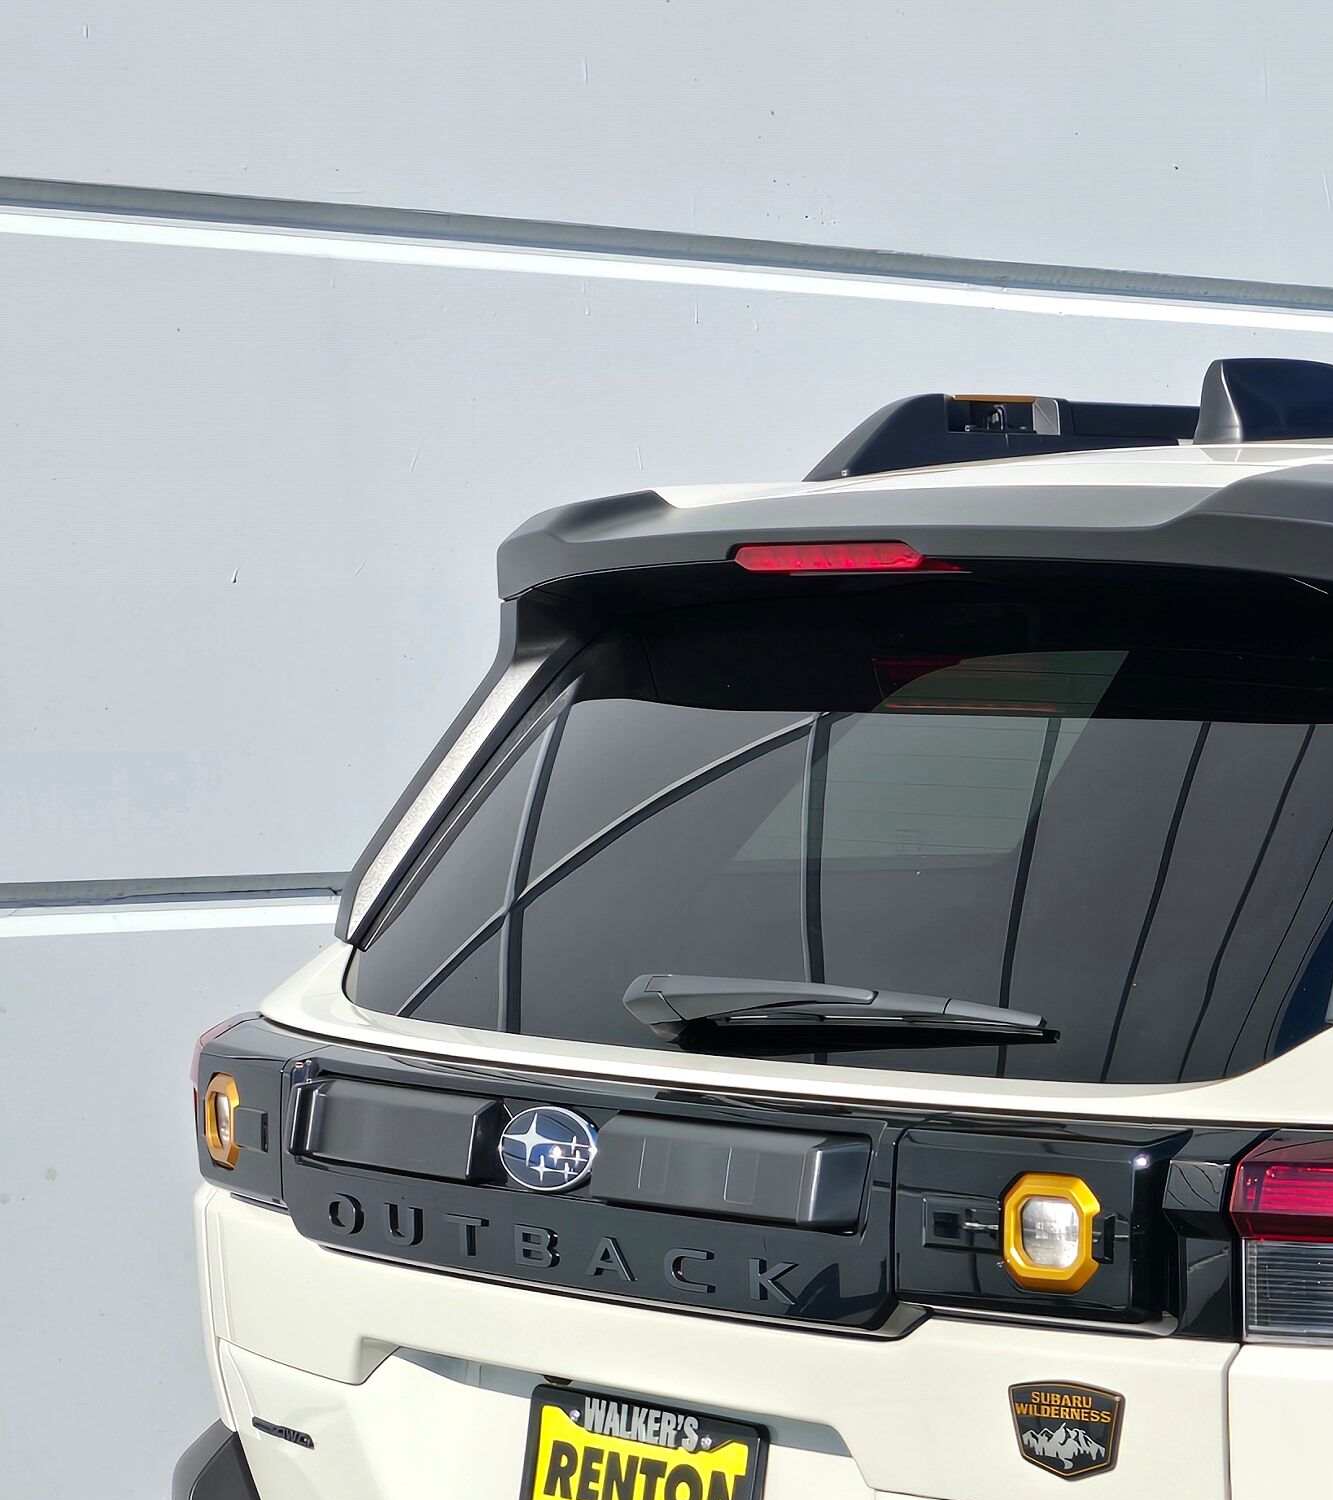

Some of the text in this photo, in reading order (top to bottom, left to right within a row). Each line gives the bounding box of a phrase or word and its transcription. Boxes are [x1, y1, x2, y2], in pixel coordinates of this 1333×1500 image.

[328, 1192, 799, 1306] OUTBACK
[1015, 1403, 1112, 1423] WILDERNESS
[1031, 1391, 1092, 1409] SUBARU
[584, 1396, 700, 1453] WALKER'S
